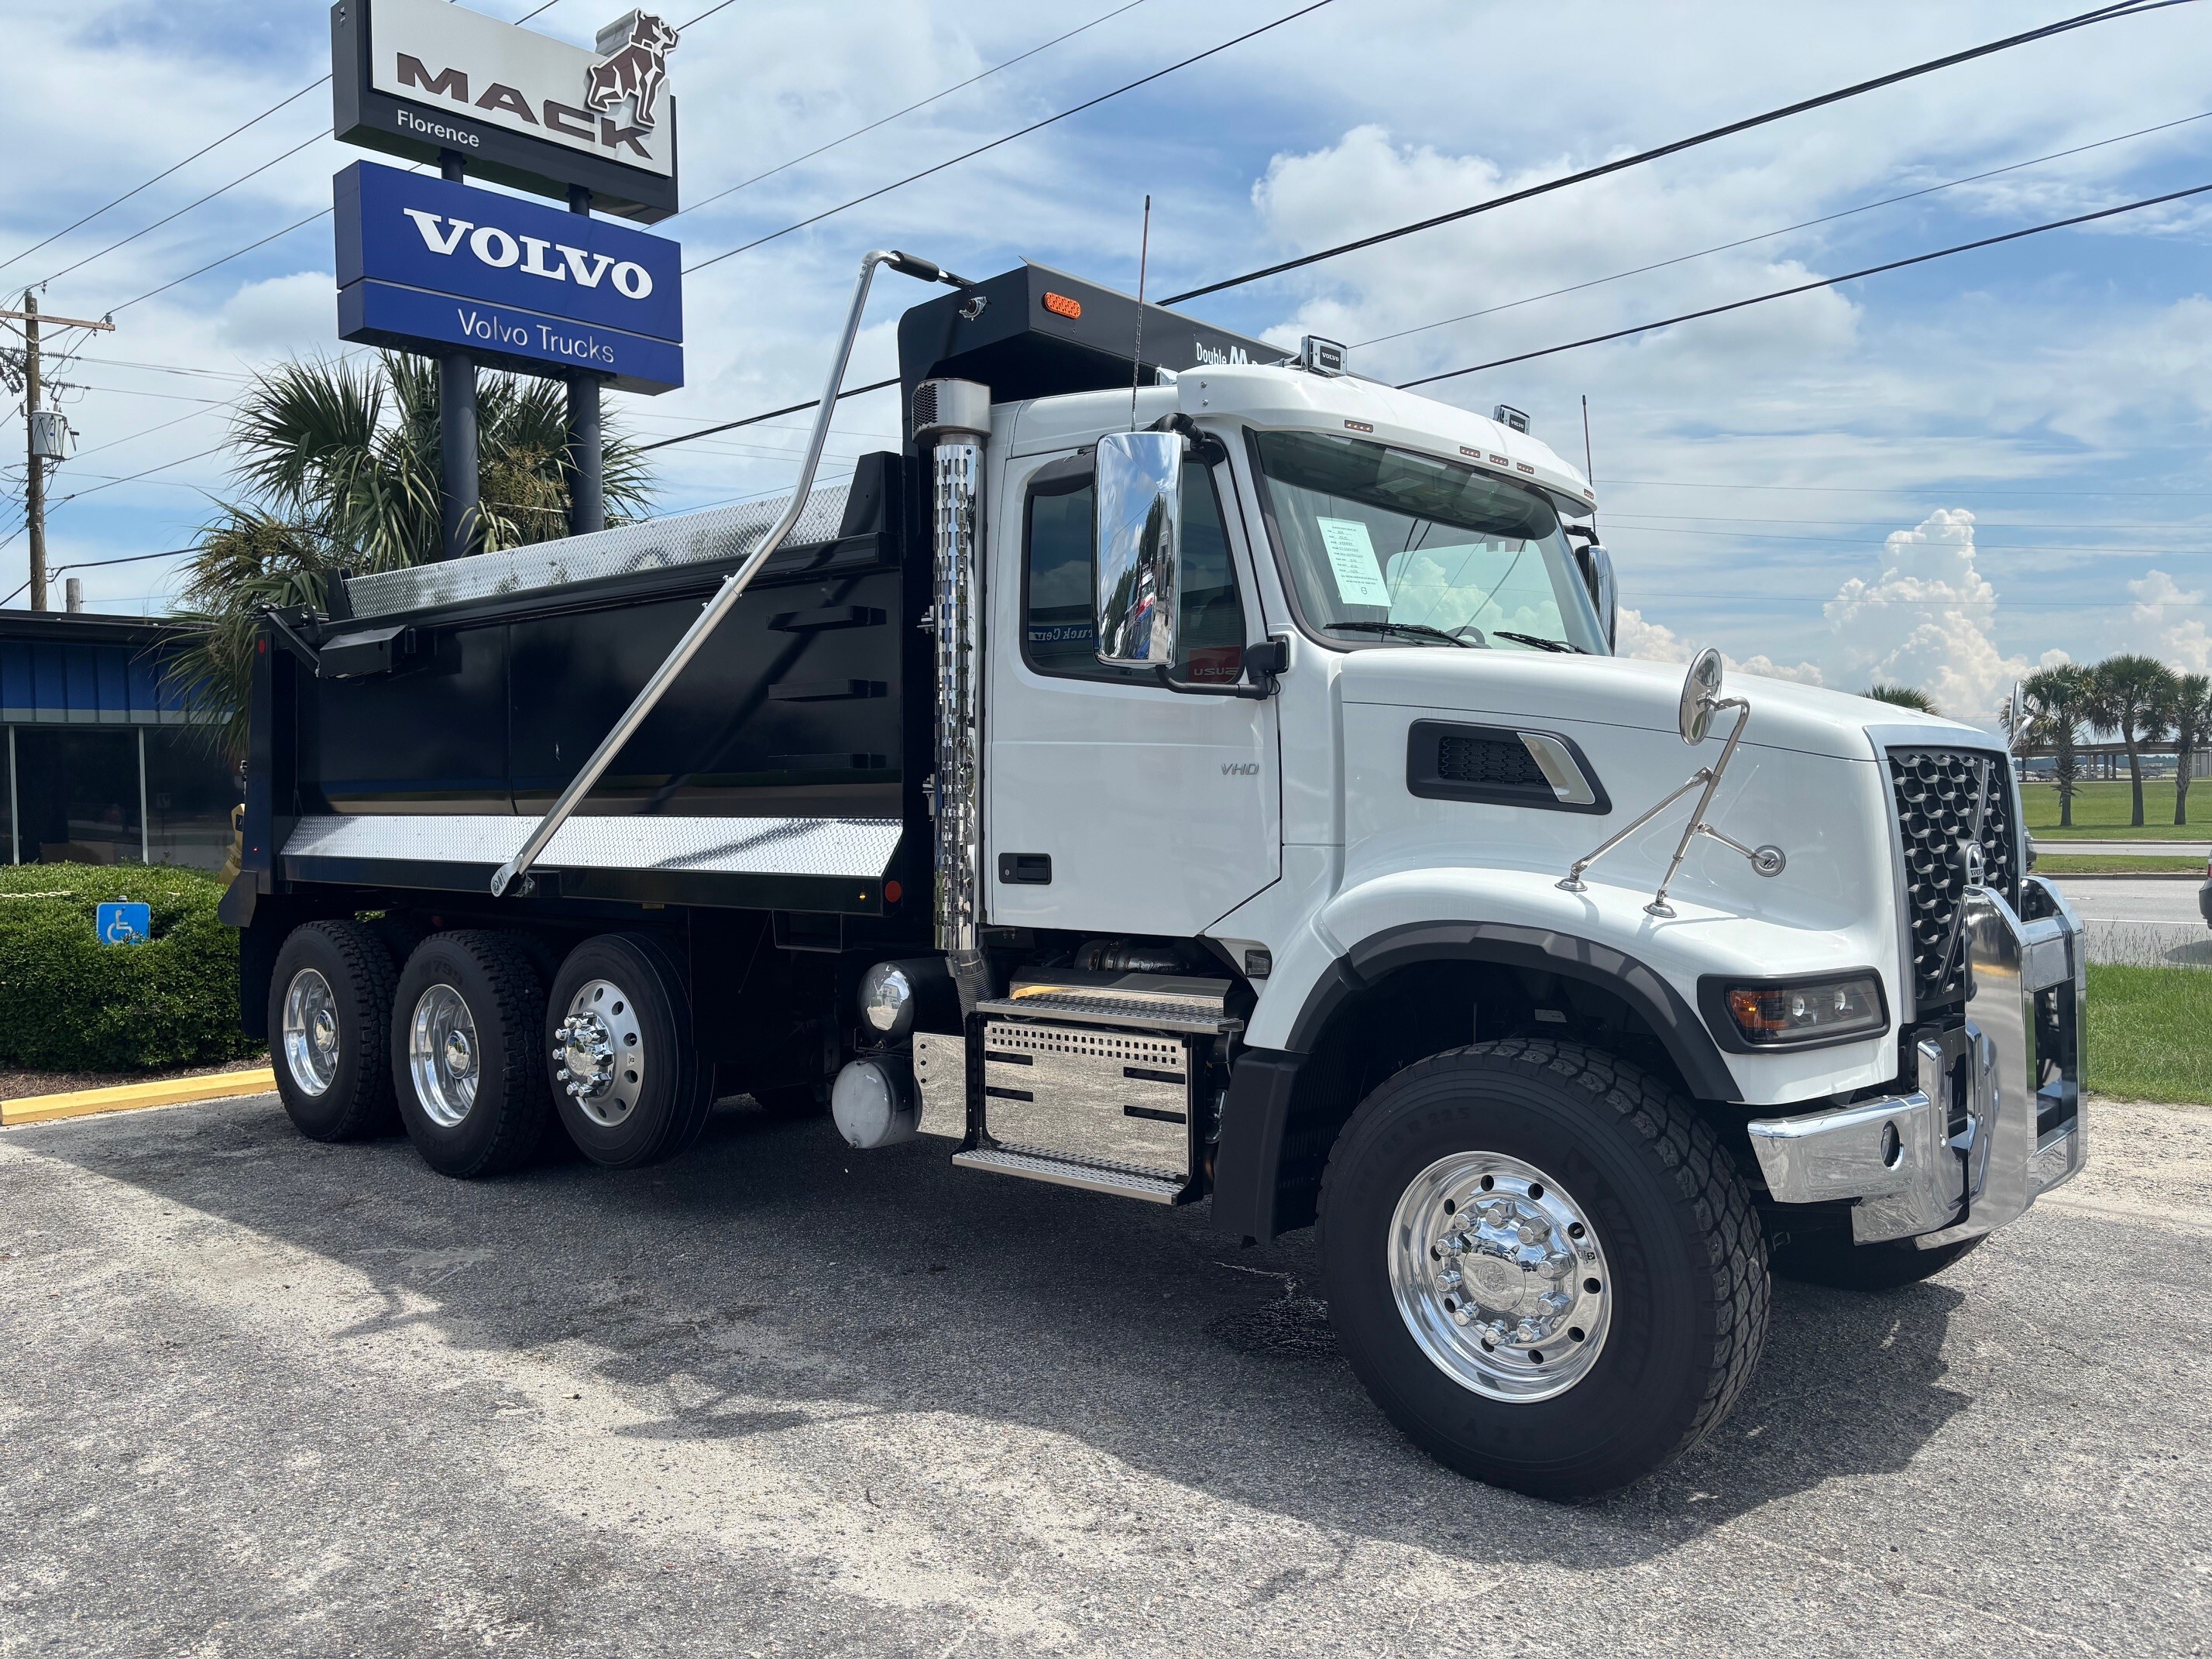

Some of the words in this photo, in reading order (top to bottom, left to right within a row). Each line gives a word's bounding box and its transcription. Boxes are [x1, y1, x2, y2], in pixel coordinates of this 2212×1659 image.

[397, 52, 654, 160] MACK
[397, 109, 480, 148] Florence
[403, 208, 654, 300] VOLVO
[457, 308, 528, 347] Volvo
[536, 324, 615, 364] Trucks
[1196, 342, 1227, 365] Double
[1321, 352, 1340, 362] VOLVO
[1221, 763, 1260, 775] VHD
